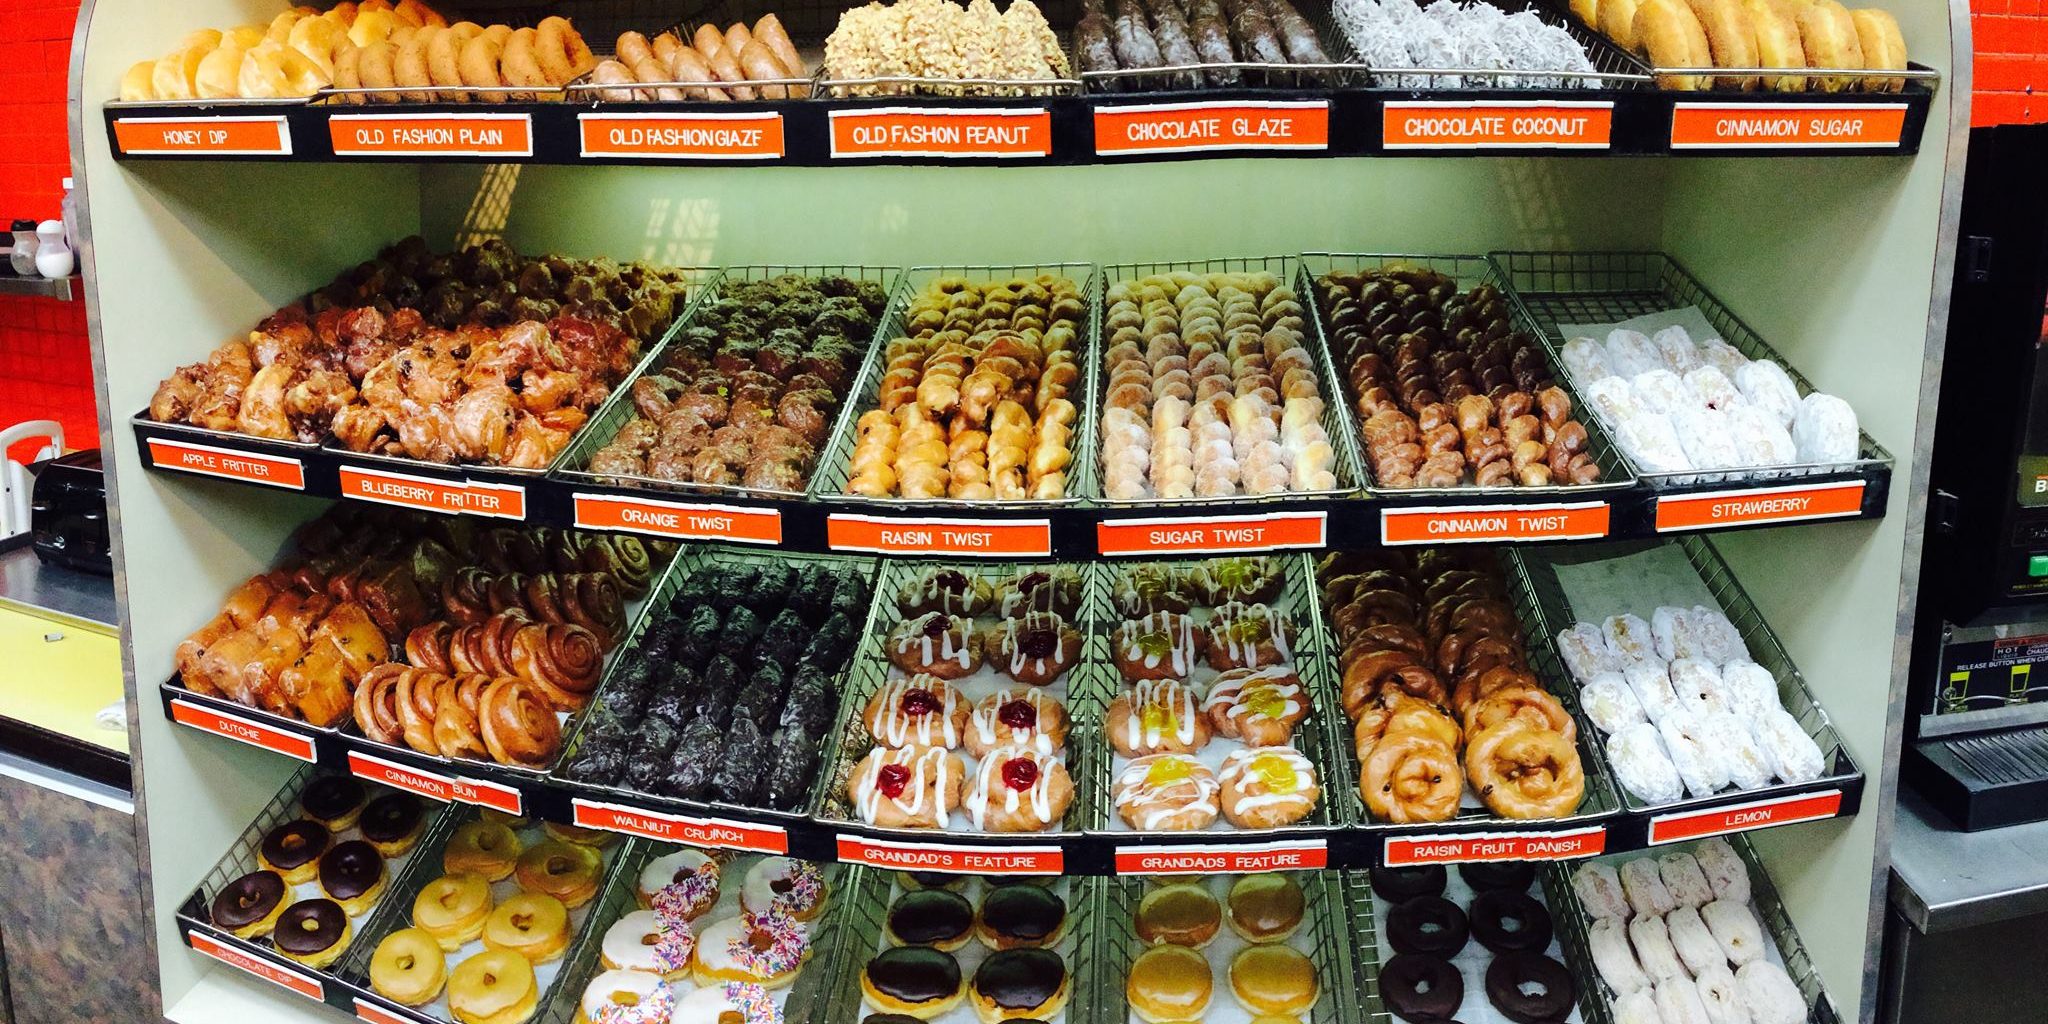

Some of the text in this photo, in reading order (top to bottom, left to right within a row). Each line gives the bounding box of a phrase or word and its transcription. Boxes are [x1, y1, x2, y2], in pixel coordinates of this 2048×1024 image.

[852, 126, 887, 145] OLD
[966, 126, 1030, 145] PEANUT
[1127, 117, 1292, 141] CHOCOLATE GLAZE
[1404, 117, 1588, 137] CHOCOLATE COCONUT
[1716, 119, 1863, 136] CINNAMON SUGAR
[163, 130, 228, 145] HONEY DIP
[356, 129, 503, 145] OLD FASHION PLAIN
[609, 128, 643, 145] OLD
[646, 128, 714, 146] FASHION
[183, 453, 269, 476] APPLE FRITTER
[361, 480, 500, 509] BLUEBERRY FRITTER
[1711, 497, 1811, 518] STRAWBERRY
[621, 508, 733, 531] ORANGE TWIST
[1427, 515, 1569, 534] CINNAMON TWIST
[881, 530, 993, 547] RAISIN TWIST
[1149, 527, 1265, 545] SUGAR TWIST
[1956, 662, 1987, 671] RELEASE
[1988, 659, 2015, 668] BUTTON
[219, 720, 260, 741] DUTCHIE
[385, 769, 478, 799] CINNAMON BUN
[1725, 809, 1772, 827] LEMON
[864, 847, 1037, 869] GRANDAD'S FEATURE
[1414, 839, 1582, 858] RAISIN FRUIT DANISH
[1141, 853, 1302, 869] GRANDADS FEATURE
[217, 947, 293, 984] CHOCOLATE DIP
